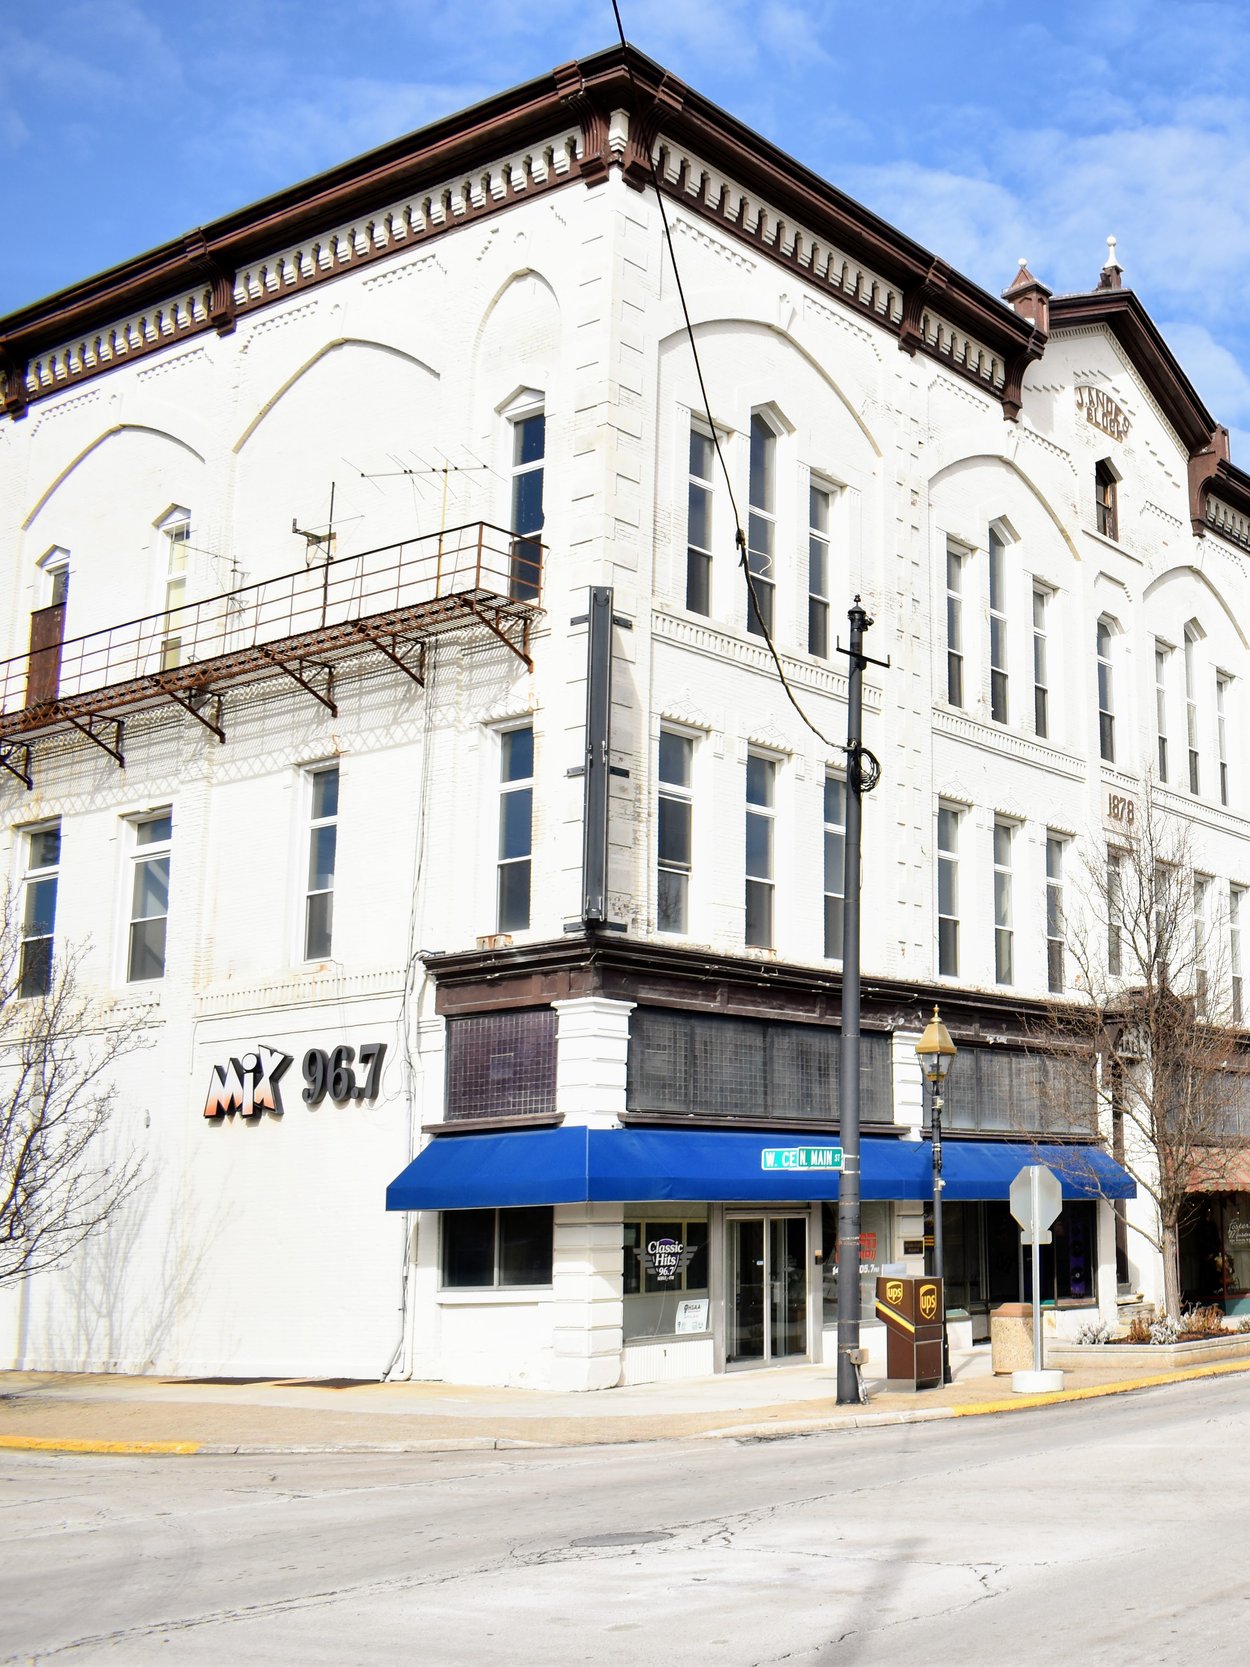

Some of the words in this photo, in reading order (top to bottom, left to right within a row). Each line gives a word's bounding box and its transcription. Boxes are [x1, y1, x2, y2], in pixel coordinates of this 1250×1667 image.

[1086, 406, 1123, 440] BLOCK
[1107, 792, 1135, 825] 1878
[301, 1043, 387, 1105] 96.7
[765, 1151, 778, 1168] W.
[781, 1151, 798, 1168] CE
[799, 1149, 808, 1166] N.
[810, 1149, 833, 1166] MAIN
[834, 1153, 841, 1162] ST
[647, 1240, 684, 1254] Classic
[655, 1253, 677, 1266] Hits
[658, 1266, 675, 1276] 96.7
[888, 1288, 902, 1301] ups
[921, 1295, 936, 1314] ups
